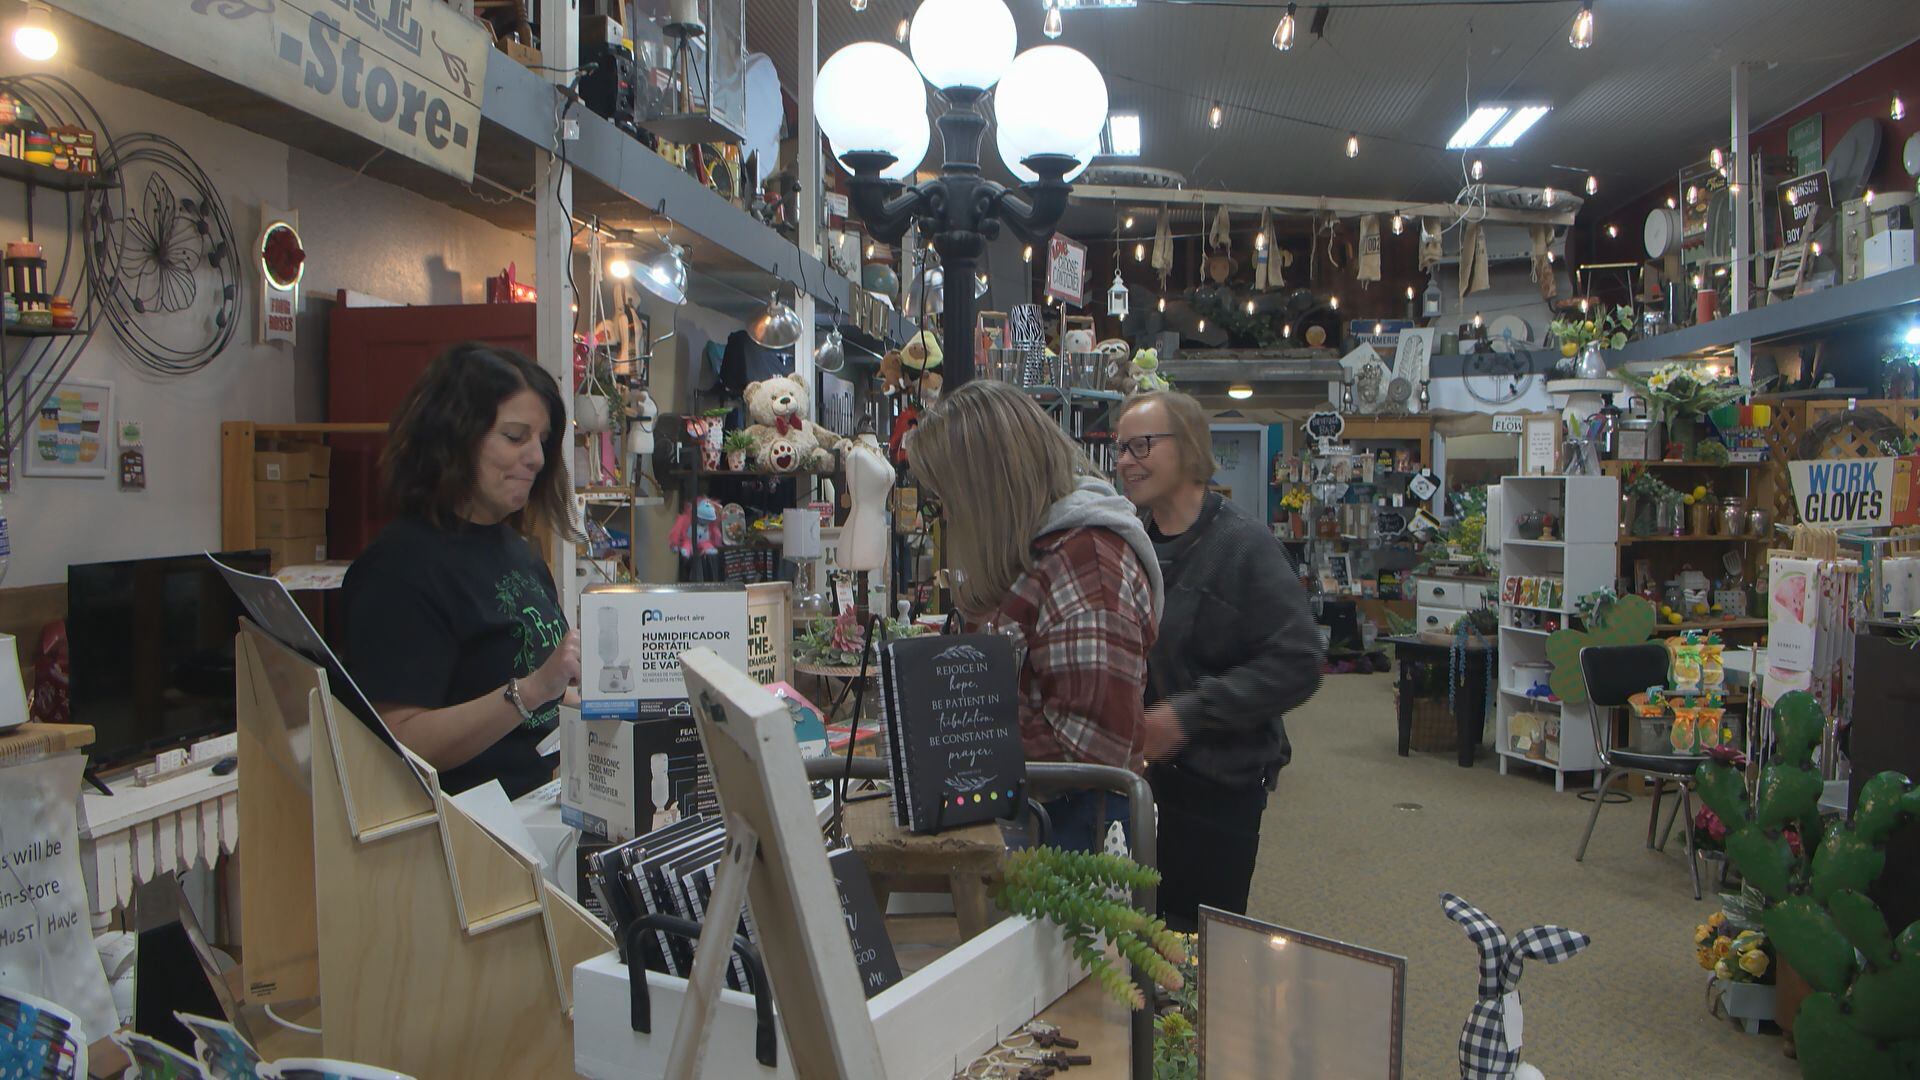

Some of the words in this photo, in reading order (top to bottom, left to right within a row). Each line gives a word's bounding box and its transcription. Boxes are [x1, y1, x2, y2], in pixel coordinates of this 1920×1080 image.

[1786, 227, 1800, 243] BOY
[1808, 461, 1878, 495] WORK
[1804, 489, 1883, 523] GLOVES
[664, 614, 691, 623] perfect
[691, 614, 705, 622] aire
[748, 614, 767, 636] LET
[642, 631, 731, 641] HUMIDIFICADOR
[642, 639, 692, 651] PORTÁTIL
[747, 636, 769, 657] THE
[642, 661, 657, 671] DE
[935, 663, 975, 676] REJOICE
[976, 662, 988, 672] IN
[748, 665, 775, 686] EGIN
[931, 699, 943, 710] BE
[945, 695, 986, 709] PATIENT
[988, 694, 1000, 704] IN
[929, 736, 941, 747] BE
[942, 729, 996, 745] CONSTANT
[996, 727, 1009, 738] IN
[588, 753, 621, 770] ULTRASONIC
[588, 763, 603, 775] COOL
[602, 767, 617, 778] MIST
[588, 772, 607, 785] TRAVEL
[588, 782, 619, 798] HUMIDIFIER
[13, 840, 42, 866] will
[45, 839, 62, 858] be
[47, 911, 78, 935] Have
